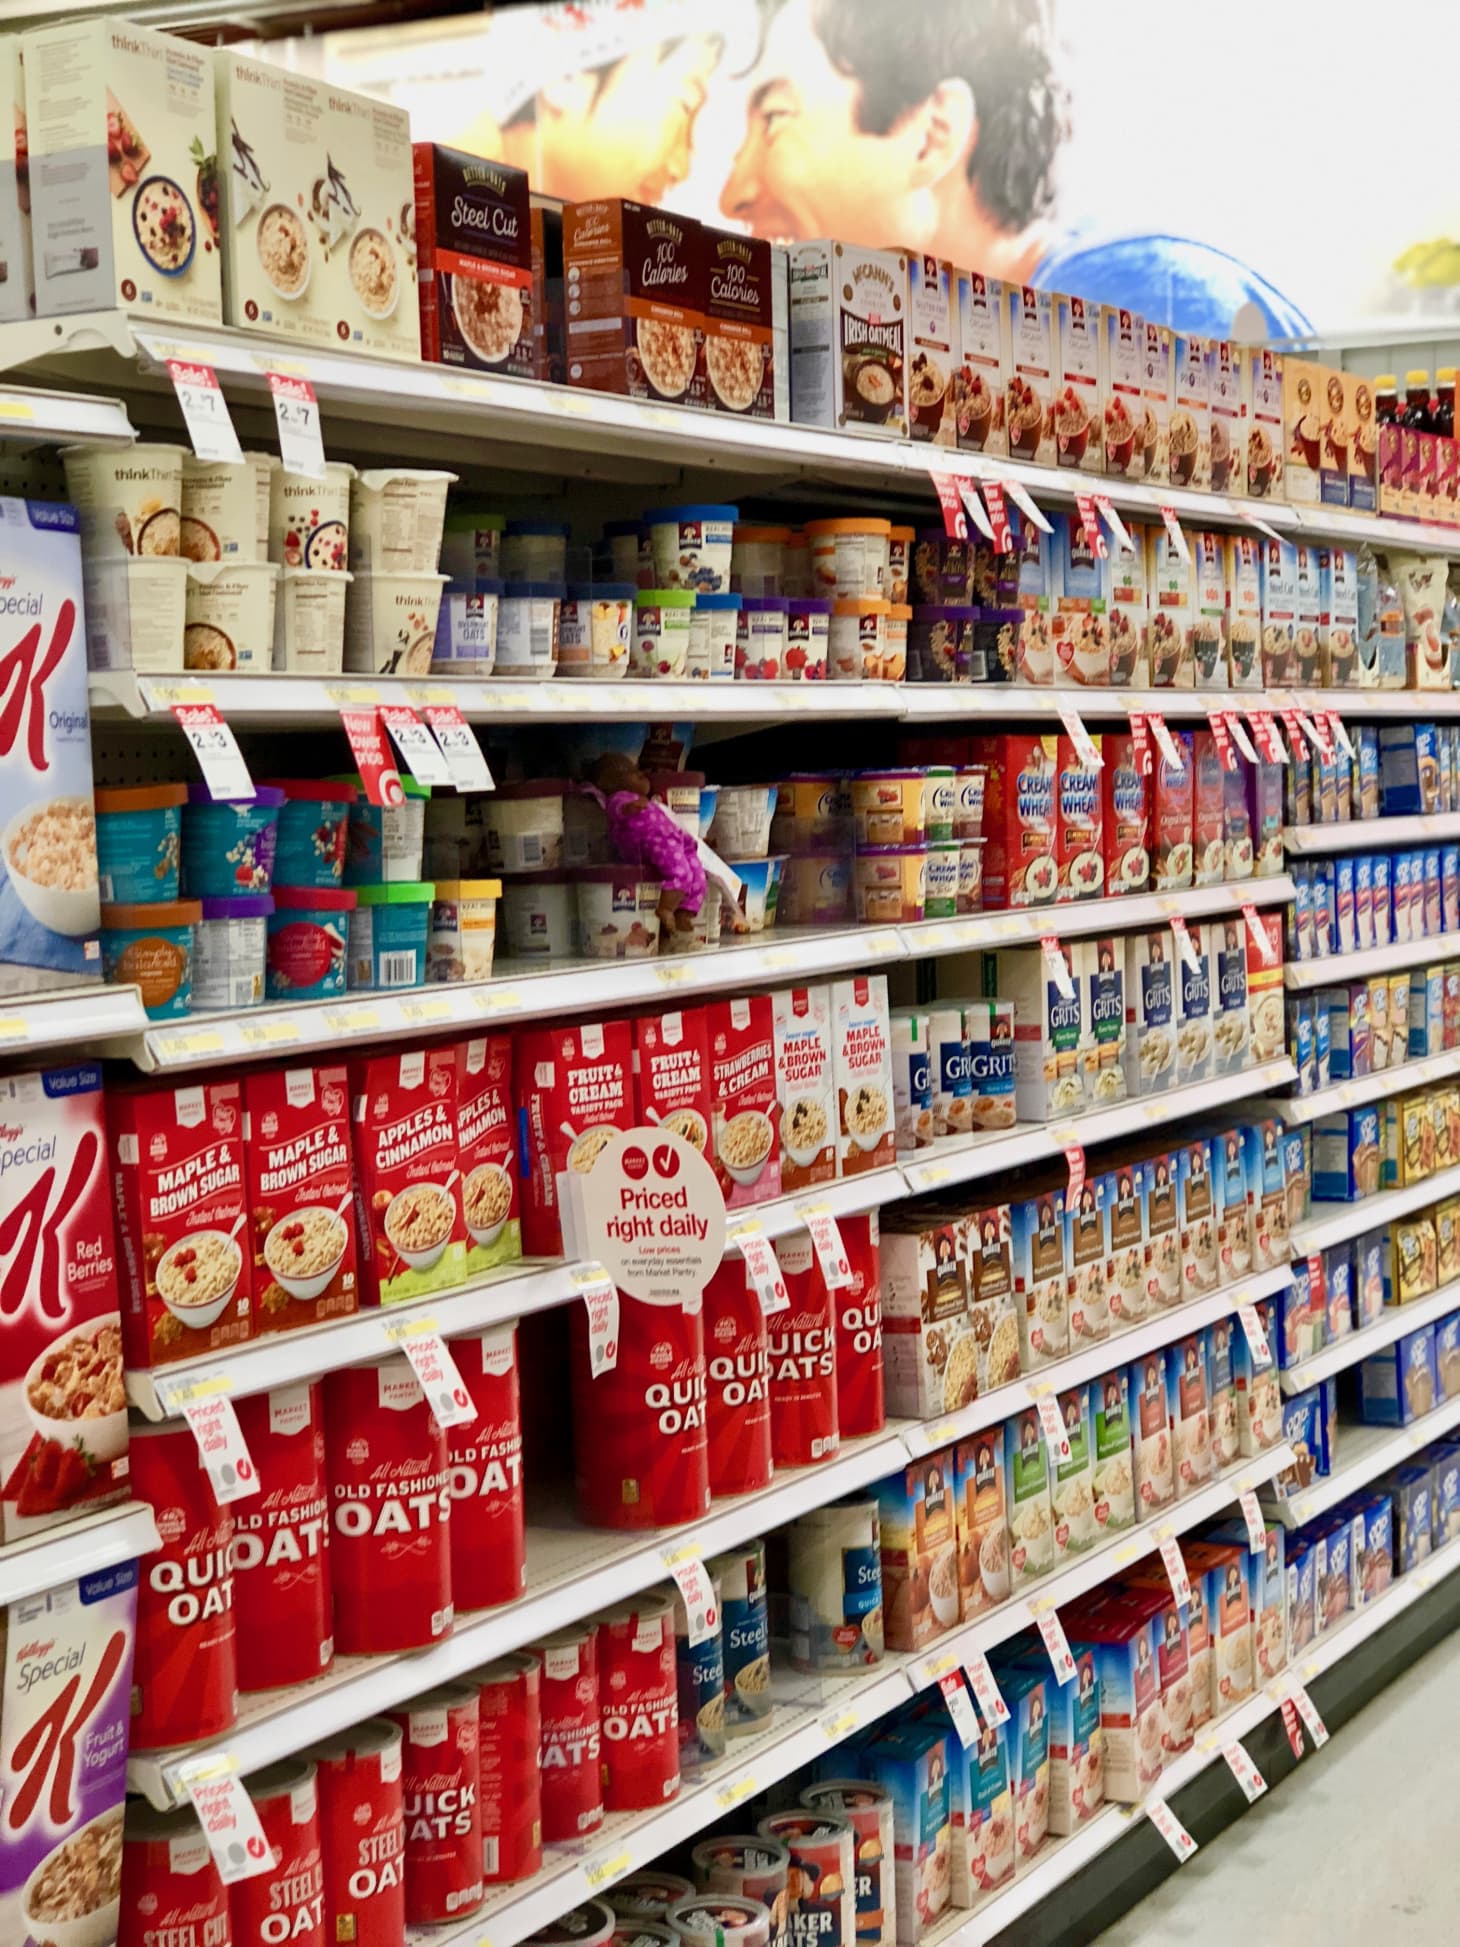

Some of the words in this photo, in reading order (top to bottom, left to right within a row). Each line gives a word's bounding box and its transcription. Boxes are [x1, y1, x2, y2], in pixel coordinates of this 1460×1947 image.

[451, 195, 489, 230] Steel
[492, 208, 519, 238] Cut
[656, 243, 675, 263] 100
[642, 256, 688, 287] Calories
[726, 264, 746, 285] 100
[711, 275, 760, 306] Calories
[844, 313, 868, 346] IRISH
[868, 323, 903, 355] OATMEAL
[49, 710, 88, 735] Original
[354, 750, 384, 768] price
[1017, 774, 1053, 796] CREAM
[1060, 773, 1098, 793] CREAM
[1061, 796, 1099, 815] WHEAT
[1184, 978, 1209, 1003] GRITS
[1221, 971, 1246, 995] GRITS
[1093, 995, 1122, 1021] GRITS
[1145, 985, 1171, 1010] GRITS
[1050, 1002, 1080, 1028] GRITS
[783, 1037, 821, 1055] MAPLE
[846, 1025, 881, 1044] MAPLE
[651, 1049, 692, 1073] FRUIT
[778, 1056, 786, 1070] &
[786, 1050, 827, 1069] BROWN
[842, 1044, 849, 1058] &
[850, 1038, 886, 1055] BROWN
[713, 1042, 773, 1081] STRAWBERRIES
[785, 1064, 822, 1083] SUGAR
[848, 1053, 882, 1070] SUGAR
[48, 1075, 77, 1091] Value
[77, 1070, 97, 1086] Size
[567, 1063, 615, 1088] FRUIT
[615, 1062, 623, 1078] &
[652, 1065, 701, 1090] CREAM
[718, 1080, 728, 1097] &
[728, 1060, 769, 1094] CREAM
[491, 1088, 502, 1107] &
[569, 1079, 624, 1105] CREAM
[654, 1086, 685, 1101] VARIETY
[570, 1100, 605, 1116] VARIETY
[378, 1107, 434, 1149] APPLES
[434, 1103, 448, 1123] &
[458, 1105, 507, 1149] INNAMON
[0, 1135, 57, 1176] pecial
[268, 1126, 326, 1170] MAPLE
[327, 1125, 340, 1144] &
[375, 1122, 454, 1170] CINNAMON
[157, 1154, 218, 1194] MAPLE
[219, 1144, 233, 1164] &
[259, 1158, 309, 1192] BROWN
[308, 1144, 348, 1175] SUGAR
[149, 1184, 199, 1218] BROWN
[199, 1163, 241, 1197] SUGAR
[619, 1185, 688, 1211] Priced
[606, 1215, 655, 1244] right
[659, 1213, 709, 1241] daily
[76, 1233, 103, 1261] Red
[638, 1246, 655, 1255] Low
[656, 1246, 681, 1257] prices
[67, 1252, 113, 1282] Berries
[627, 1269, 645, 1277] from
[645, 1268, 672, 1277] Market
[672, 1268, 697, 1279] Pantry
[631, 1257, 665, 1268] everyday
[666, 1256, 703, 1265] essentials
[342, 1273, 355, 1288] 10
[236, 1297, 249, 1313] 10
[722, 1375, 769, 1406] OAT
[273, 1402, 308, 1418] MARKET
[658, 1403, 708, 1435] OAT
[449, 1453, 524, 1501] OAT
[334, 1482, 372, 1499] OLD
[84, 1578, 112, 1598] Value
[113, 1567, 134, 1588] Size
[168, 1577, 235, 1626] OAT
[729, 1624, 766, 1649] Steel
[16, 1641, 87, 1694] Special
[602, 1704, 627, 1717] OLD
[9, 1629, 127, 1831] K
[85, 1730, 115, 1752] Fruit
[82, 1738, 125, 1770] Yogurt
[538, 1732, 600, 1769] ATS
[408, 1811, 473, 1842] ATS
[348, 1852, 405, 1899] OAT
[268, 1874, 313, 1911] STEEL
[259, 1895, 324, 1944] OAT
